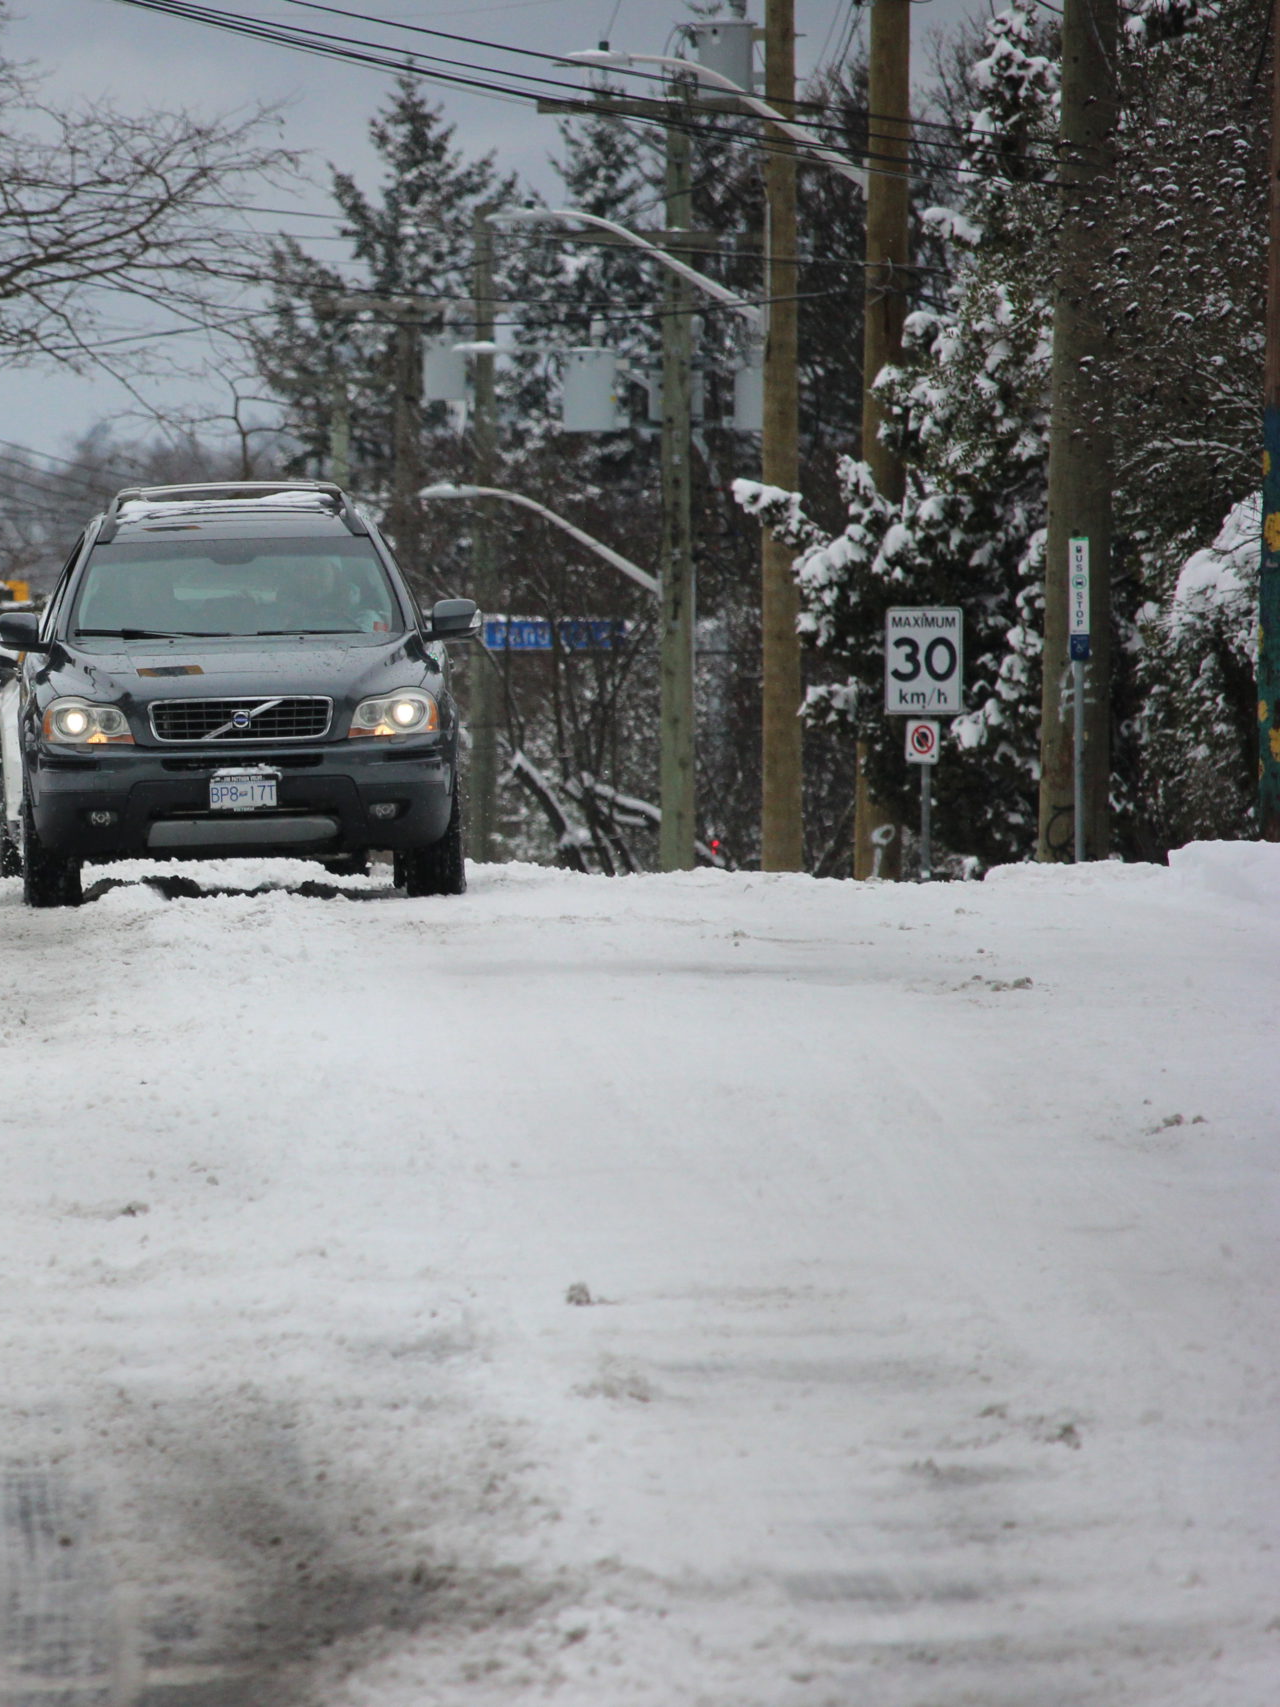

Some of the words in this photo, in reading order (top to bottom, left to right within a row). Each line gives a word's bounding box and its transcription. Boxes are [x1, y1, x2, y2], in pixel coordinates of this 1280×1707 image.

[1075, 545, 1083, 572] BUS
[891, 616, 956, 629] MAXIMUM
[1076, 592, 1084, 627] STOP
[890, 636, 957, 682] 30
[898, 688, 948, 706] km/h
